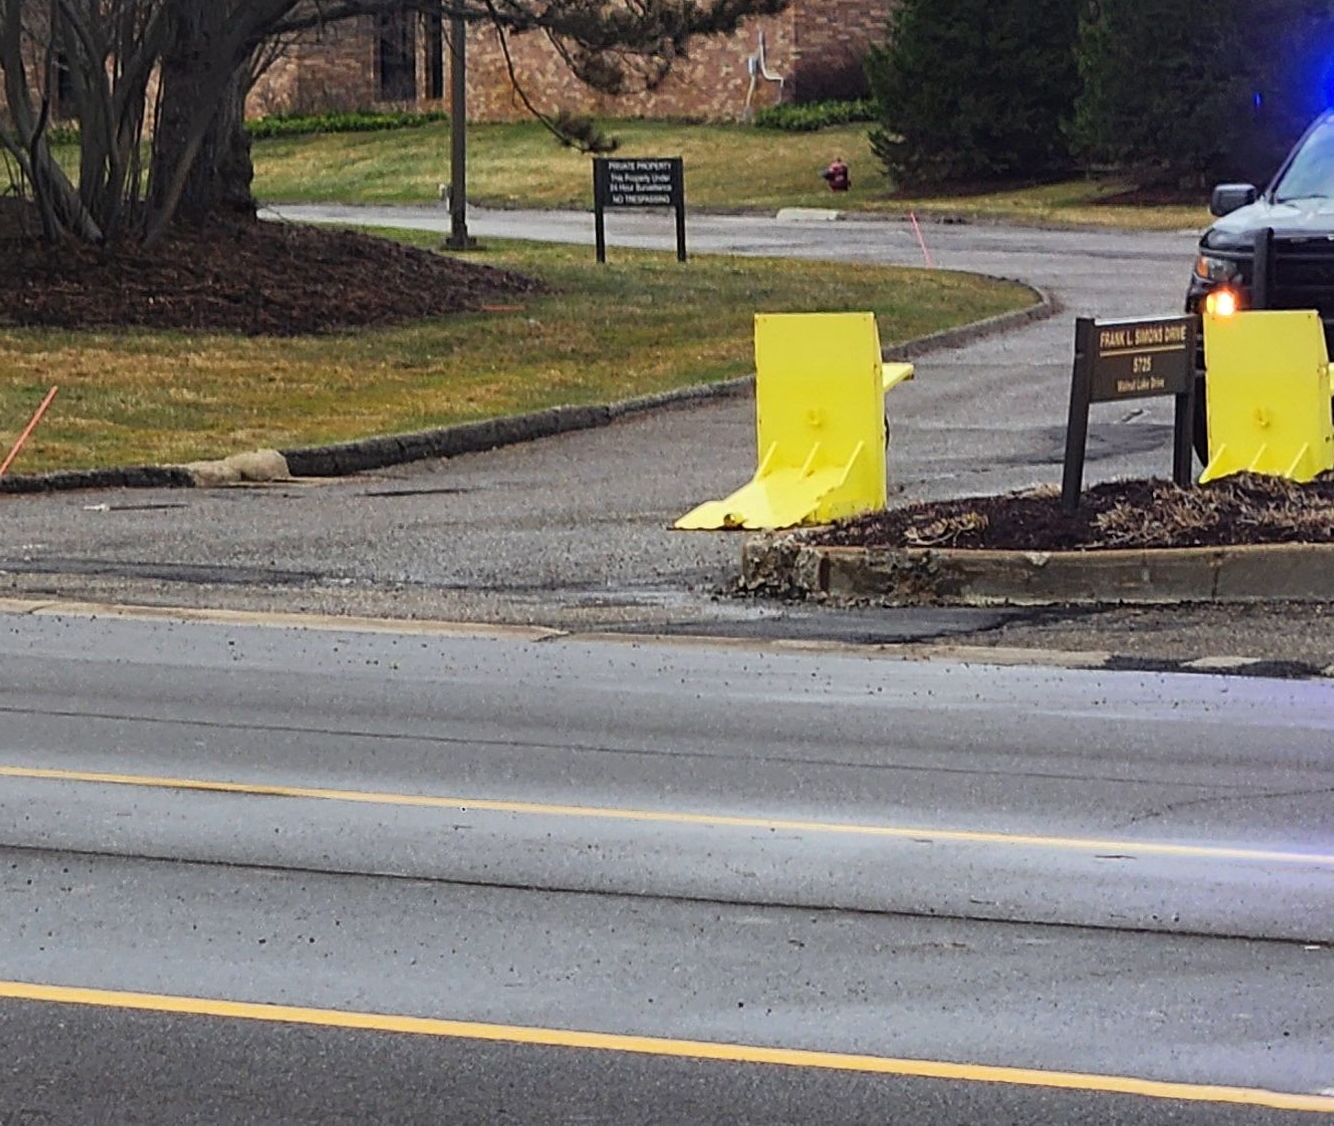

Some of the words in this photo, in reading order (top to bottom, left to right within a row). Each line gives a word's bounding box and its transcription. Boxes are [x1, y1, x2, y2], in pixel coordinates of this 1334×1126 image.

[1099, 330, 1126, 348] FRANK
[1126, 330, 1134, 346] L.
[1164, 324, 1188, 342] DRIVE
[1132, 356, 1152, 373] 5725
